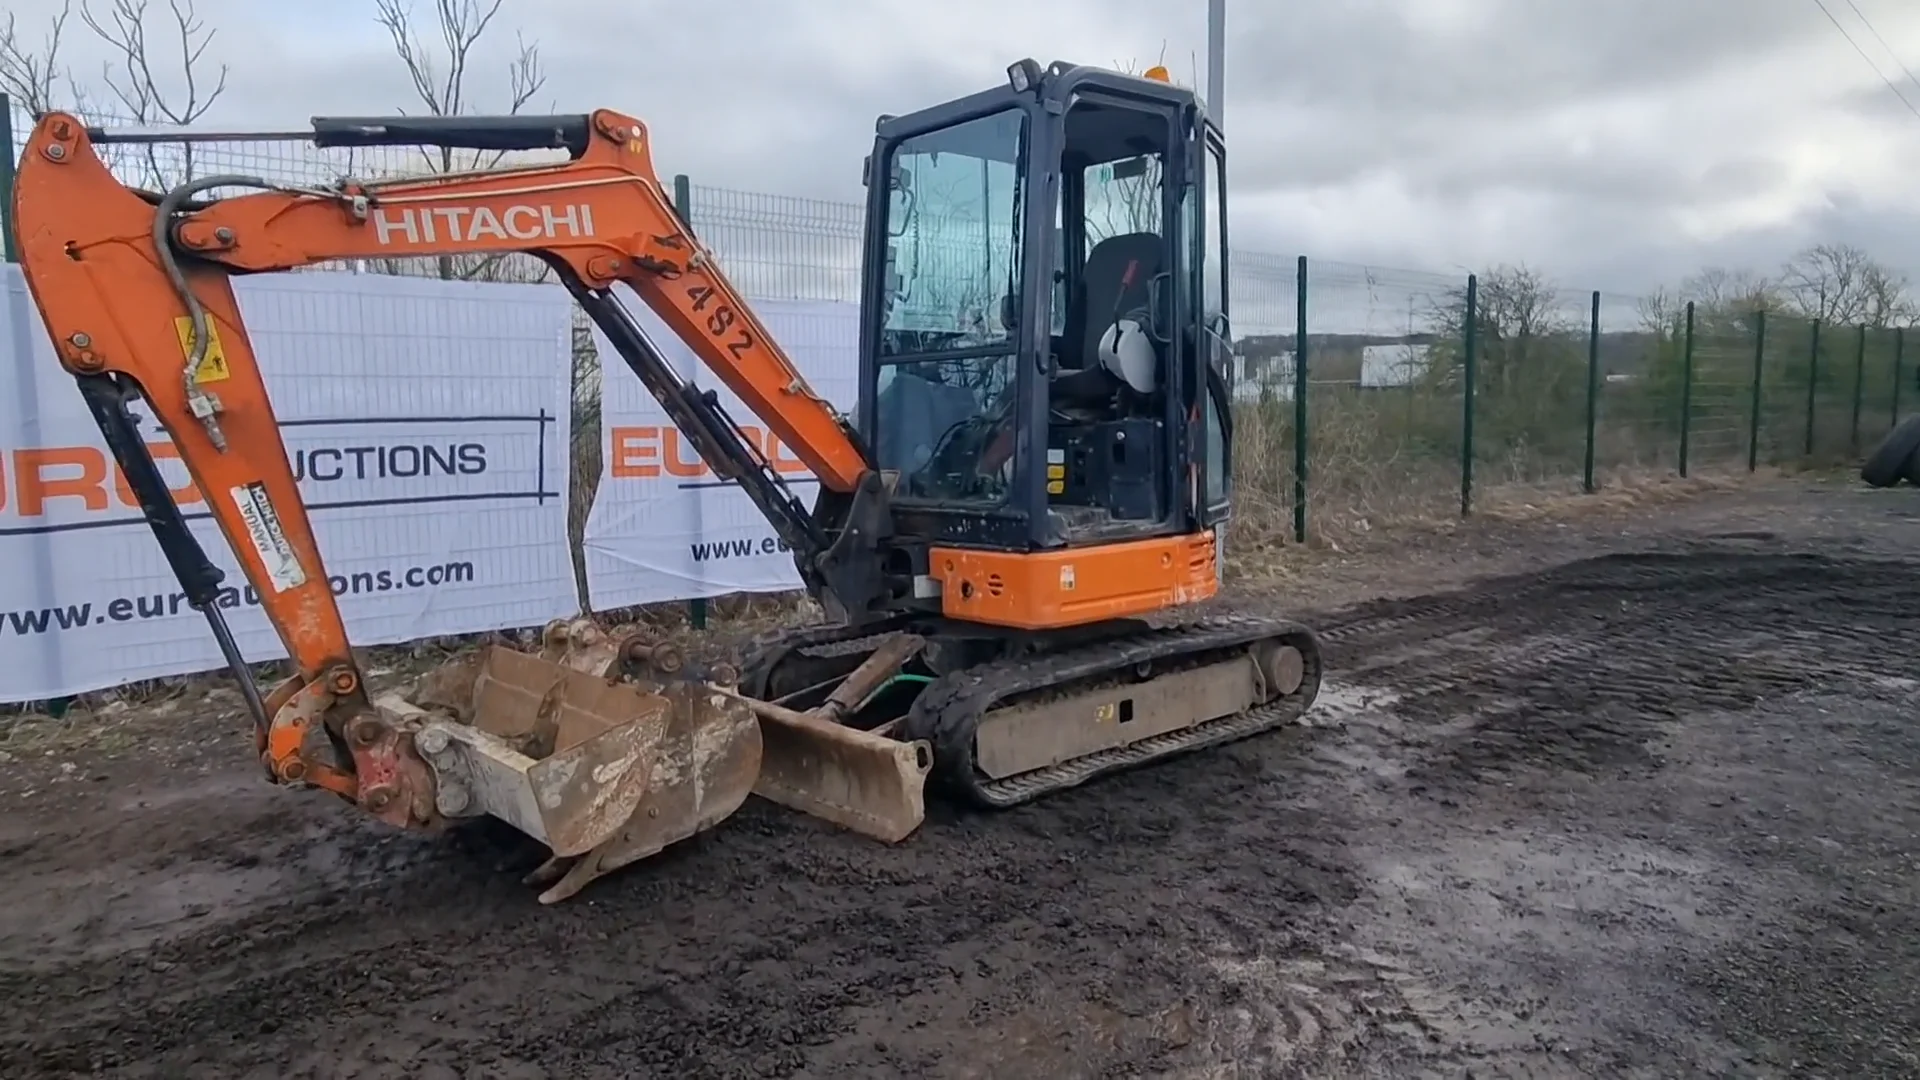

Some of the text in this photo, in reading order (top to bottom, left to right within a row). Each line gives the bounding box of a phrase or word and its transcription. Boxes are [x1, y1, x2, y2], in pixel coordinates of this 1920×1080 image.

[374, 203, 595, 245] HITACHI
[296, 443, 487, 482] CTIONS
[241, 501, 269, 552] MANUAL
